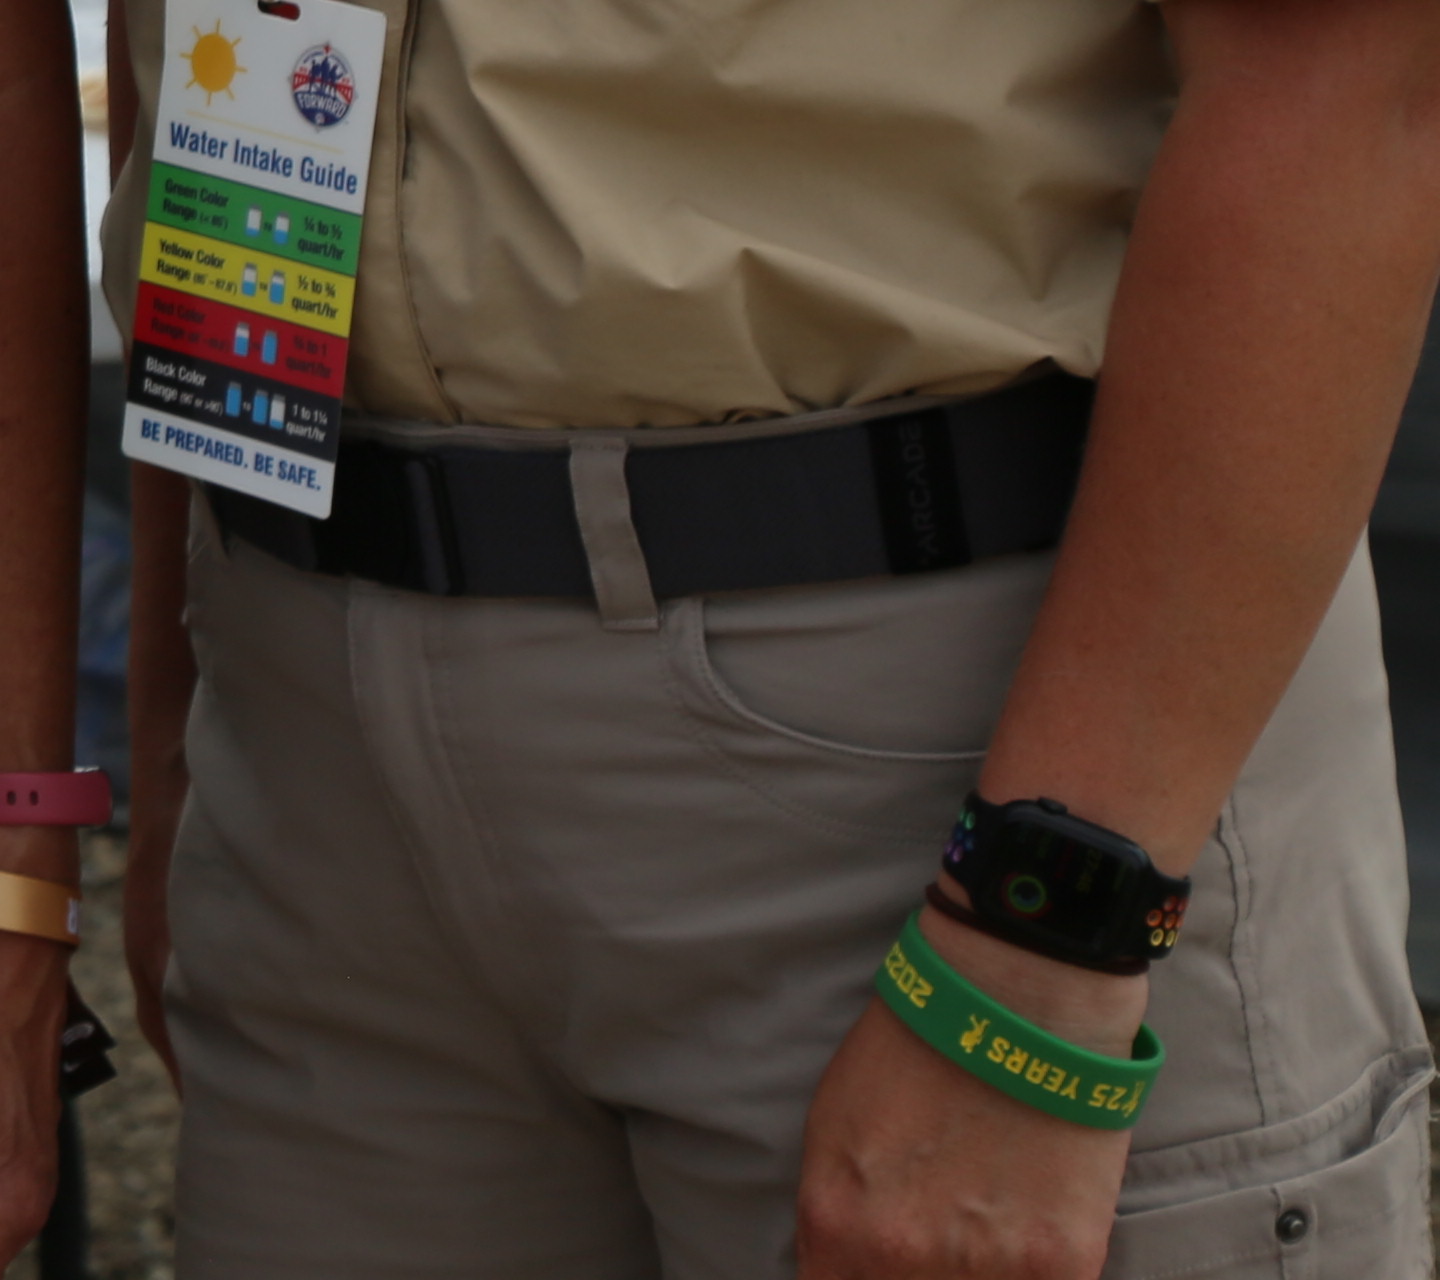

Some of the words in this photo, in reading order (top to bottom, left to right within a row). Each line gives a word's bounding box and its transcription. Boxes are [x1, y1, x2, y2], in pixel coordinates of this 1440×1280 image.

[170, 120, 229, 160] Water
[233, 138, 293, 178] Intake
[300, 156, 358, 195] Guide
[164, 178, 198, 202] Green
[199, 185, 230, 208] Color
[159, 238, 195, 262] Yellow
[196, 249, 225, 270] Color
[156, 258, 191, 284] Range
[292, 297, 338, 320] quart/hr
[146, 356, 176, 378] Black
[178, 366, 207, 387] Color
[143, 378, 178, 403] Range
[286, 420, 327, 443] quart/hr
[141, 418, 161, 443] BE
[165, 424, 249, 470] PREPARED.
[253, 452, 274, 474] BE
[277, 460, 322, 491] SAFE.
[986, 1036, 1081, 1100] YEARS
[1088, 1083, 1127, 1111] 25
